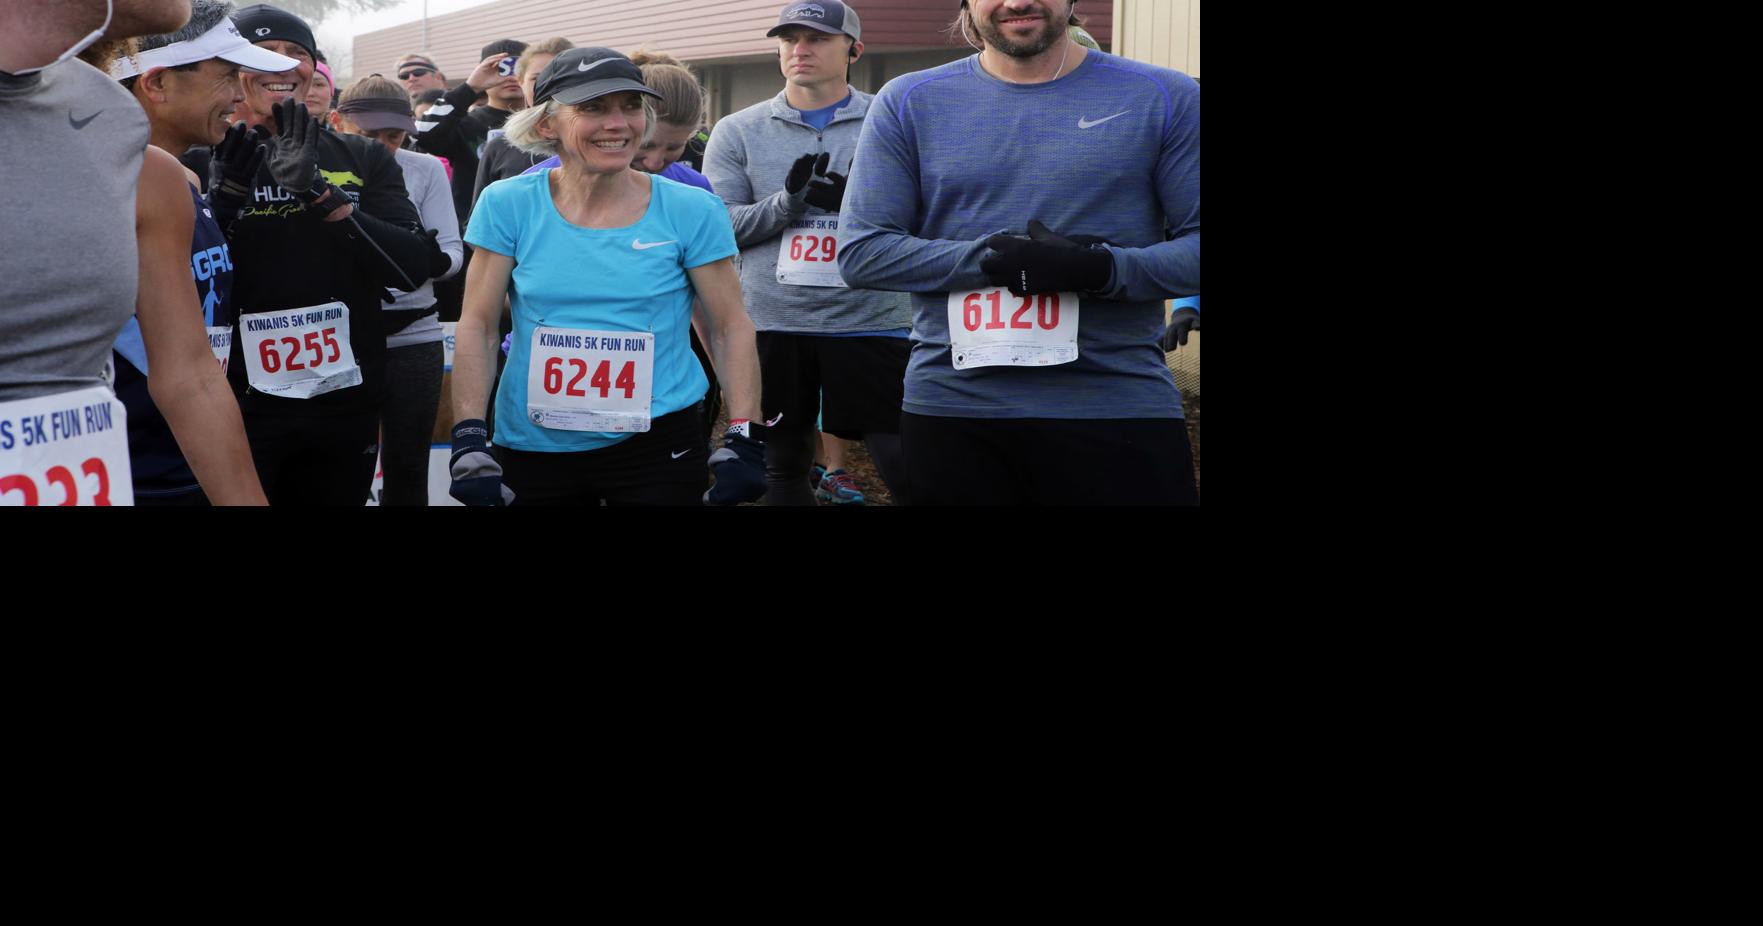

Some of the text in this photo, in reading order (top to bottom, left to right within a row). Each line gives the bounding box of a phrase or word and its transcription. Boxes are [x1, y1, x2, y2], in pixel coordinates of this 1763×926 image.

[254, 185, 297, 202] HLO
[793, 219, 815, 230] ANIS
[816, 219, 827, 230] 5K
[789, 234, 837, 263] 629
[247, 307, 343, 332] KIWANIS 5K FUN RUN
[963, 290, 1060, 332] 6120
[258, 327, 341, 374] 6255
[540, 333, 646, 352] KIWANIS 5K FUN RUN
[543, 356, 636, 399] 6244
[21, 414, 48, 446] 5K
[51, 408, 82, 441] FUN
[84, 401, 113, 434] RUN
